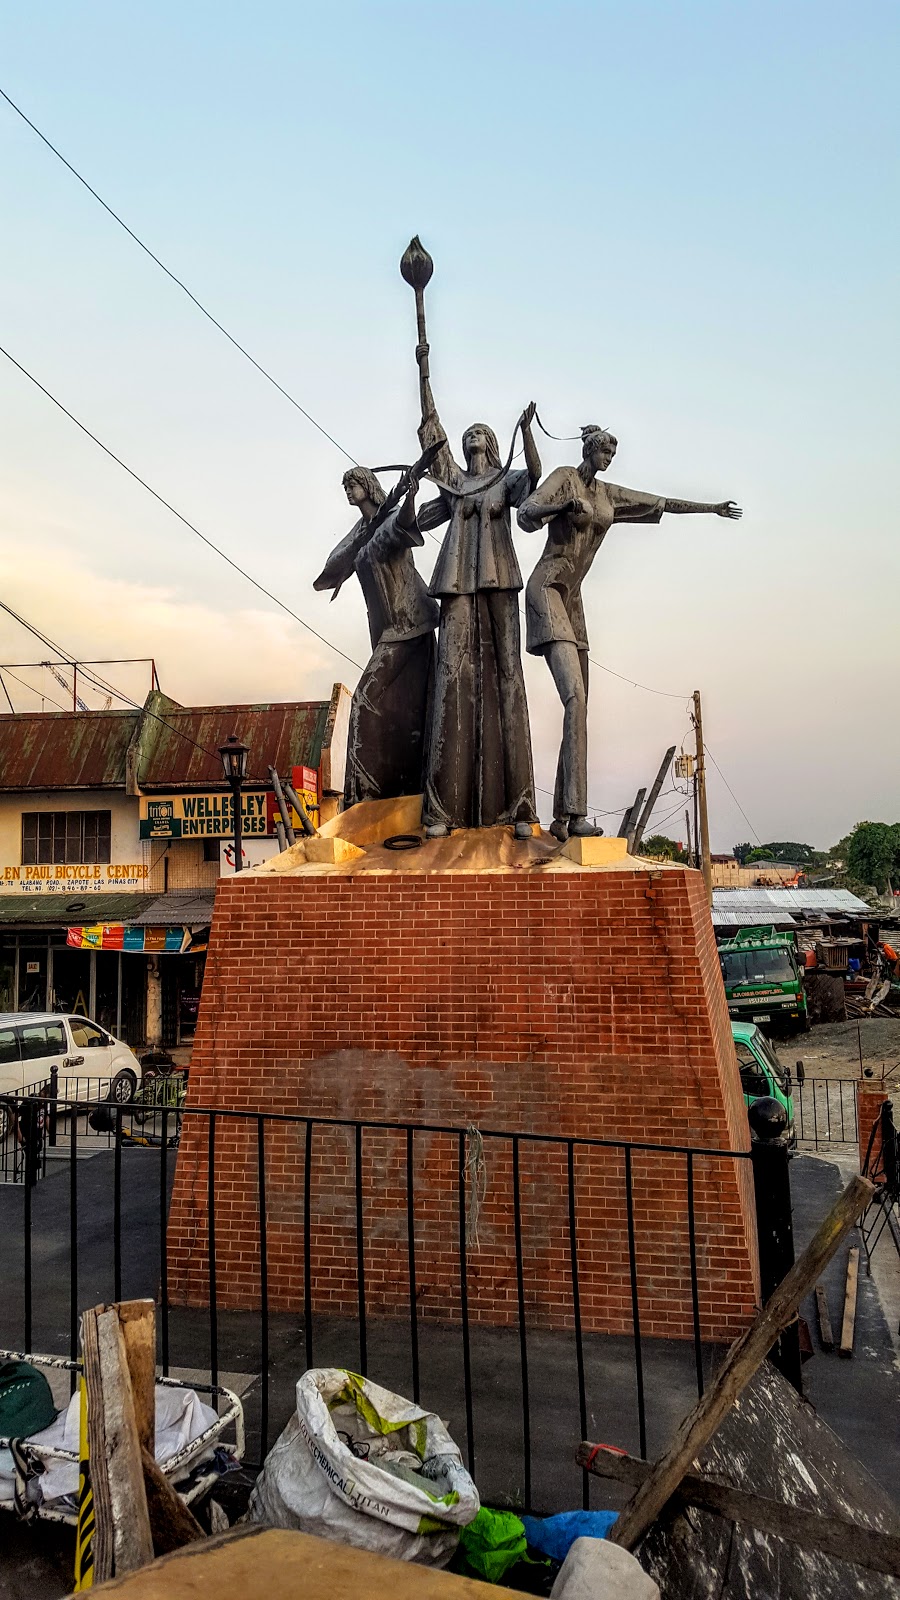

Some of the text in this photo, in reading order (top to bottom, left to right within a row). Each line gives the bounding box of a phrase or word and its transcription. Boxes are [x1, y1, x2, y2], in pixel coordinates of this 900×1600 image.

[149, 805, 173, 817] triton
[182, 795, 265, 817] WELLESLEY
[183, 816, 266, 835] ENTERPRSES
[0, 864, 149, 880] EN PAUL BICYCLE CENTER
[313, 1446, 349, 1495] CHEMICAL
[356, 1493, 390, 1517] TITAN
